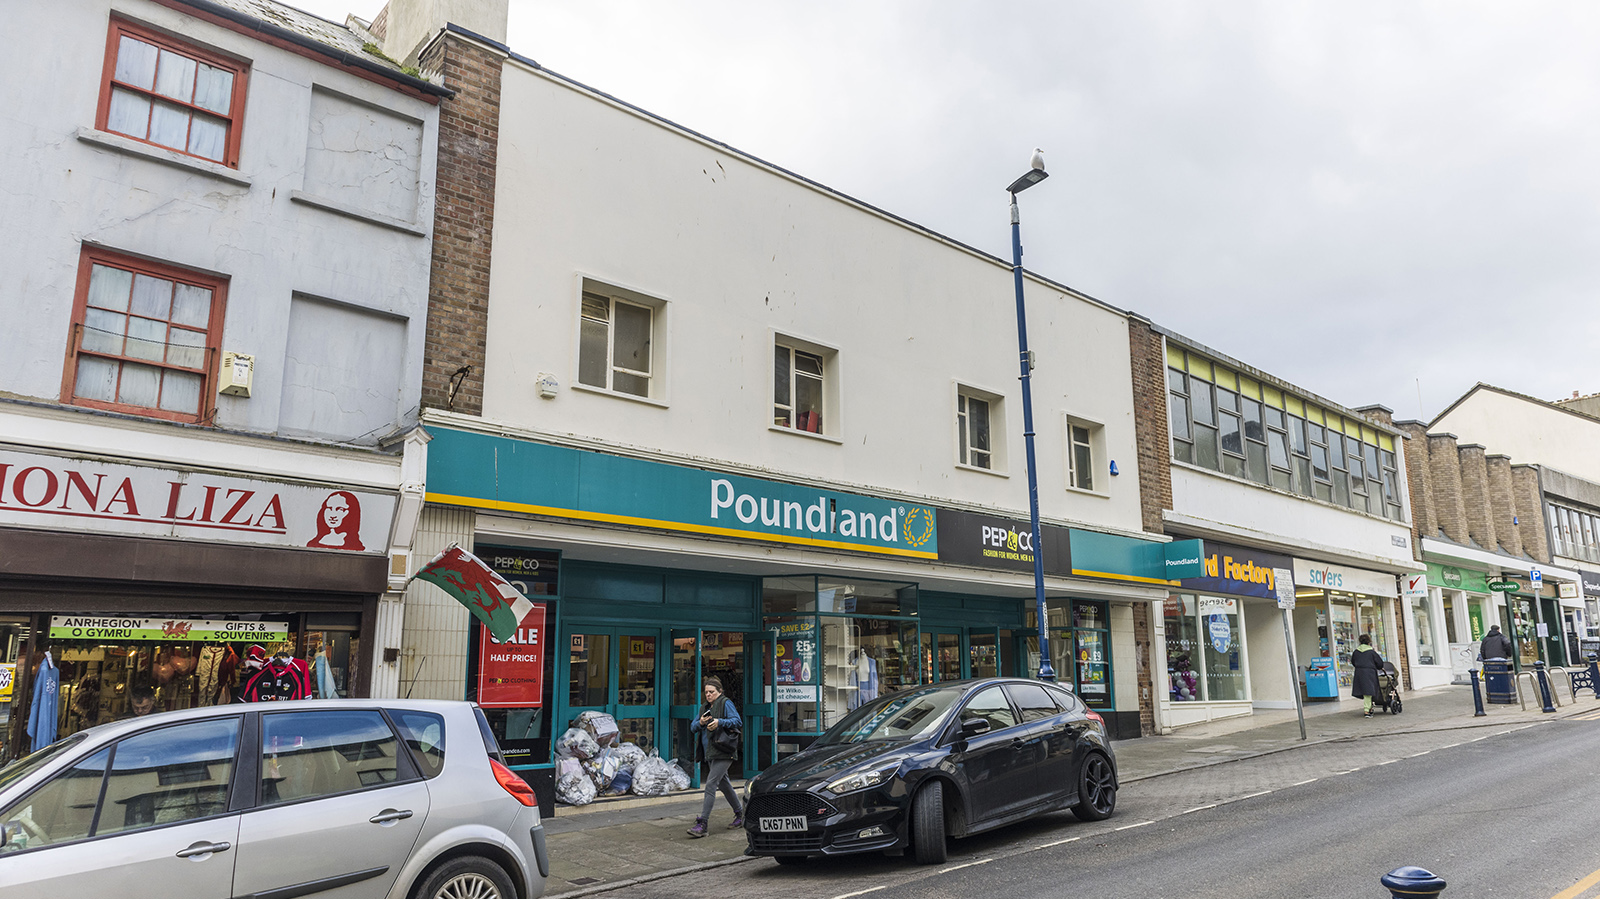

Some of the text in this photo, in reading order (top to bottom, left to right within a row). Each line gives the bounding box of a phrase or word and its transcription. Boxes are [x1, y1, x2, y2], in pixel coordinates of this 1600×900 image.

[160, 481, 287, 530] LIZA
[710, 478, 898, 542] Poundland
[494, 555, 539, 570] PEP&CO
[1165, 557, 1199, 567] Poundland
[1204, 554, 1219, 577] rd
[1223, 556, 1275, 591] Factory
[1309, 567, 1343, 587] savers
[1532, 571, 1540, 580] P
[63, 618, 142, 628] ANRHEGION
[225, 622, 266, 631] GIFTS &
[72, 628, 132, 638] O GYMRU
[781, 624, 800, 633] SAVE
[214, 631, 275, 640] SOUVENIRS
[633, 643, 642, 652] £1
[490, 654, 537, 662] HALF PRICE!
[763, 818, 804, 831] CK67 PNN
